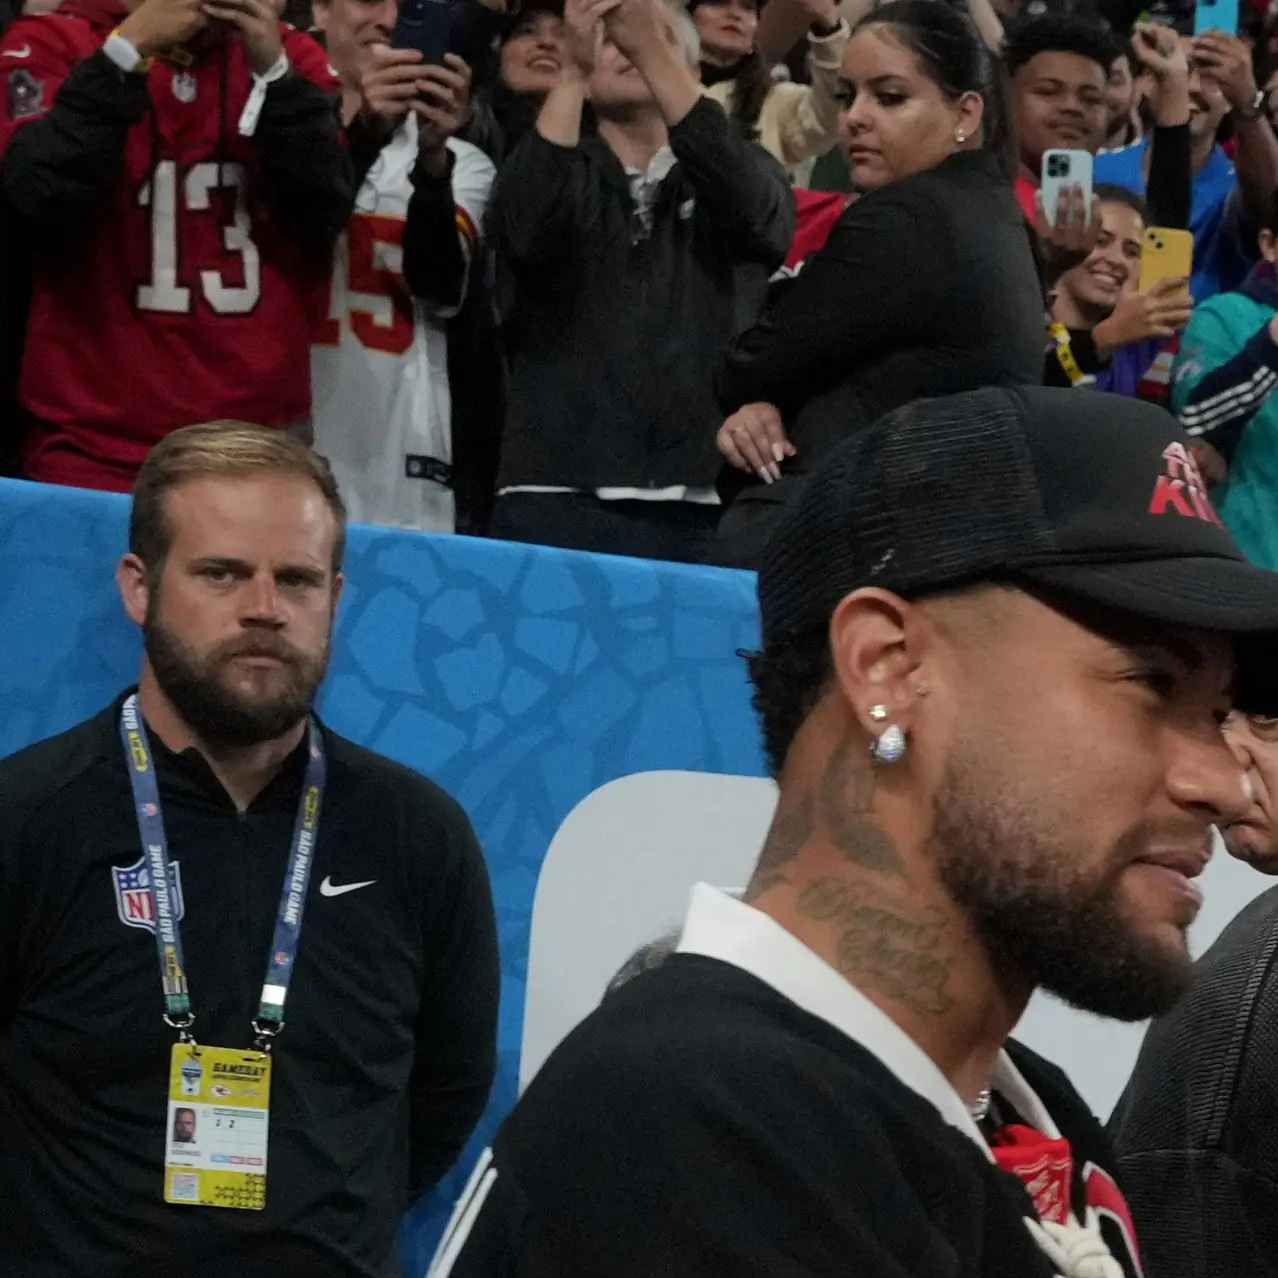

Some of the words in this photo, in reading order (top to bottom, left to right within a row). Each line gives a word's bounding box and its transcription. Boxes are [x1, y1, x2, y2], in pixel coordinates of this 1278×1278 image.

[137, 158, 261, 315] 13
[149, 844, 166, 879] GAME
[290, 854, 308, 892] PAULO
[154, 880, 172, 917] PAULO
[283, 891, 302, 926] GAME
